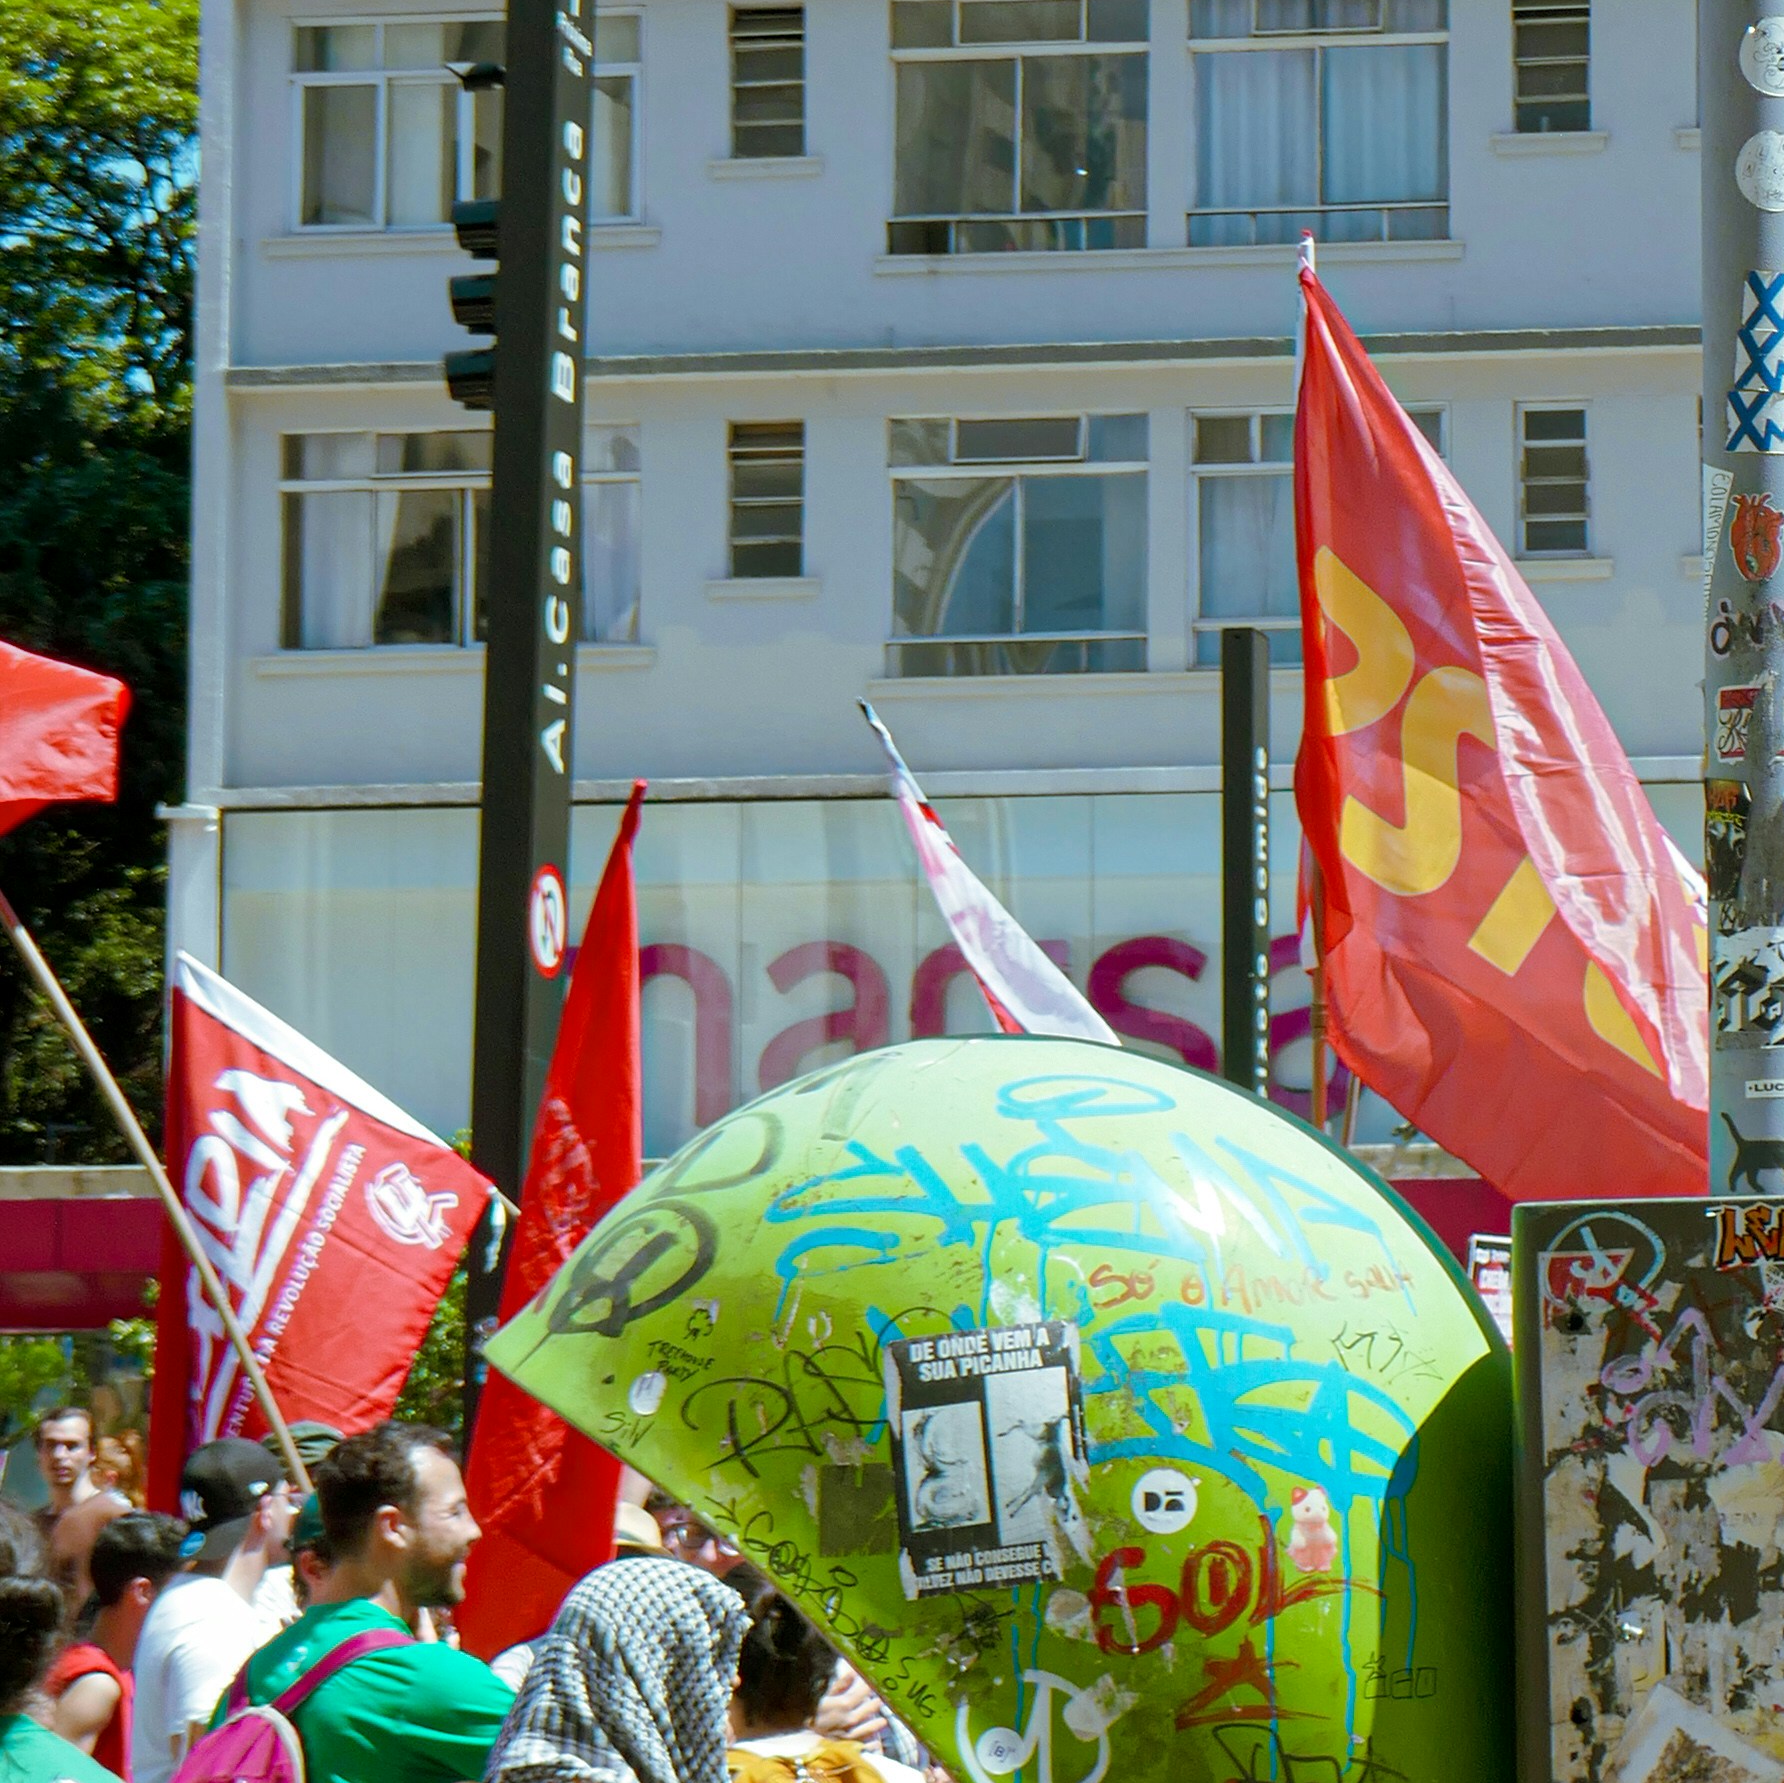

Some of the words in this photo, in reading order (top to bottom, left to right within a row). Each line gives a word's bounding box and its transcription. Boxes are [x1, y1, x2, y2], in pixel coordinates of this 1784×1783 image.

[551, 120, 583, 404] Branca
[545, 450, 573, 644] Casa
[541, 662, 568, 774] Al.
[1253, 745, 1268, 927] Gomide
[265, 1230, 328, 1335] REVOLUÇÃO
[317, 1142, 368, 1239] SOCIALISTA
[909, 1341, 935, 1363] DE
[936, 1334, 988, 1358] ONDE
[990, 1329, 1032, 1351] VEM
[1035, 1327, 1050, 1347] A
[919, 1361, 958, 1382] SUA
[959, 1348, 1044, 1376] PICANHA
[926, 1557, 944, 1572] SE
[944, 1551, 973, 1570] NÃO
[973, 1543, 1042, 1566] CONSEGUE
[955, 1567, 984, 1586] NÃO
[984, 1560, 1041, 1582] DEVESSE
